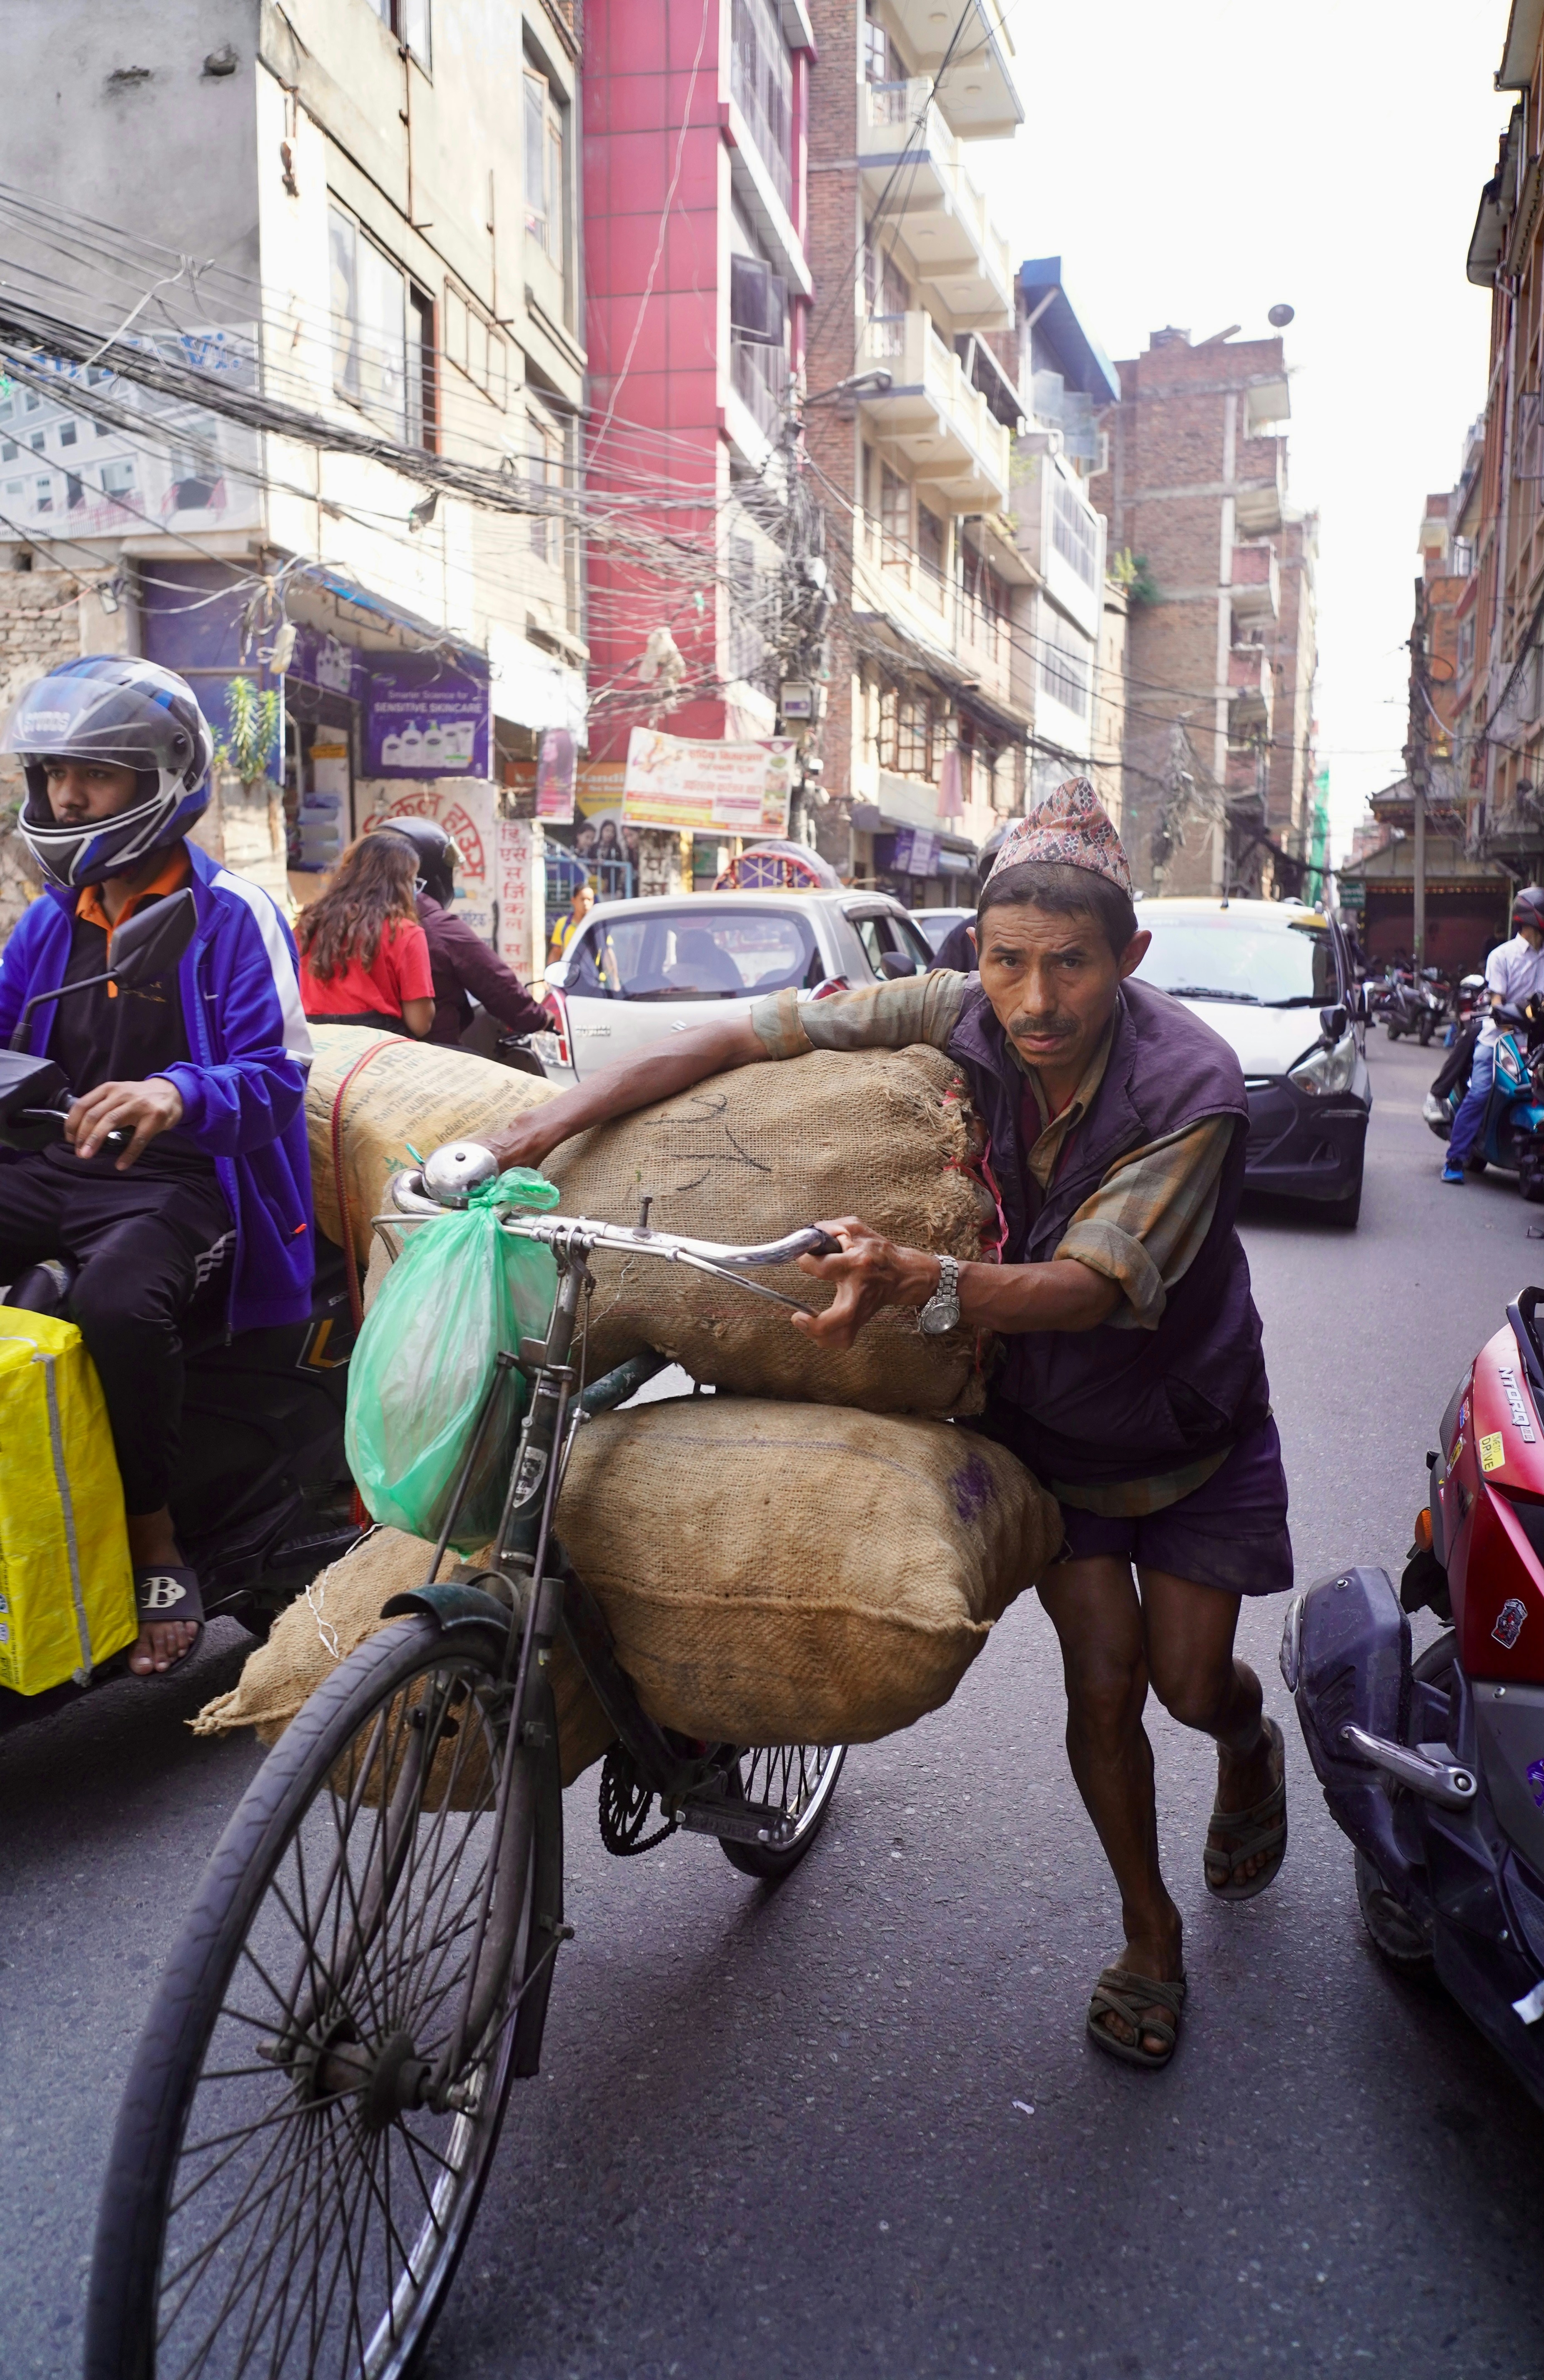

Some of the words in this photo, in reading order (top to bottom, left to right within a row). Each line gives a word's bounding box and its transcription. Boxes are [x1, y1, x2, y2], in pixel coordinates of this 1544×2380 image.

[374, 702, 428, 713] SENSITIVE
[429, 703, 483, 713] SKINCARE
[361, 1045, 424, 1077] UREA
[374, 1106, 396, 1124] Salt
[393, 1084, 426, 1109] Trading
[435, 1118, 466, 1144] Indian
[462, 1101, 489, 1123] Potash
[486, 1079, 514, 1108] Limited
[1498, 1366, 1531, 1427] NTORQ
[1481, 1437, 1494, 1470] DRIVE
